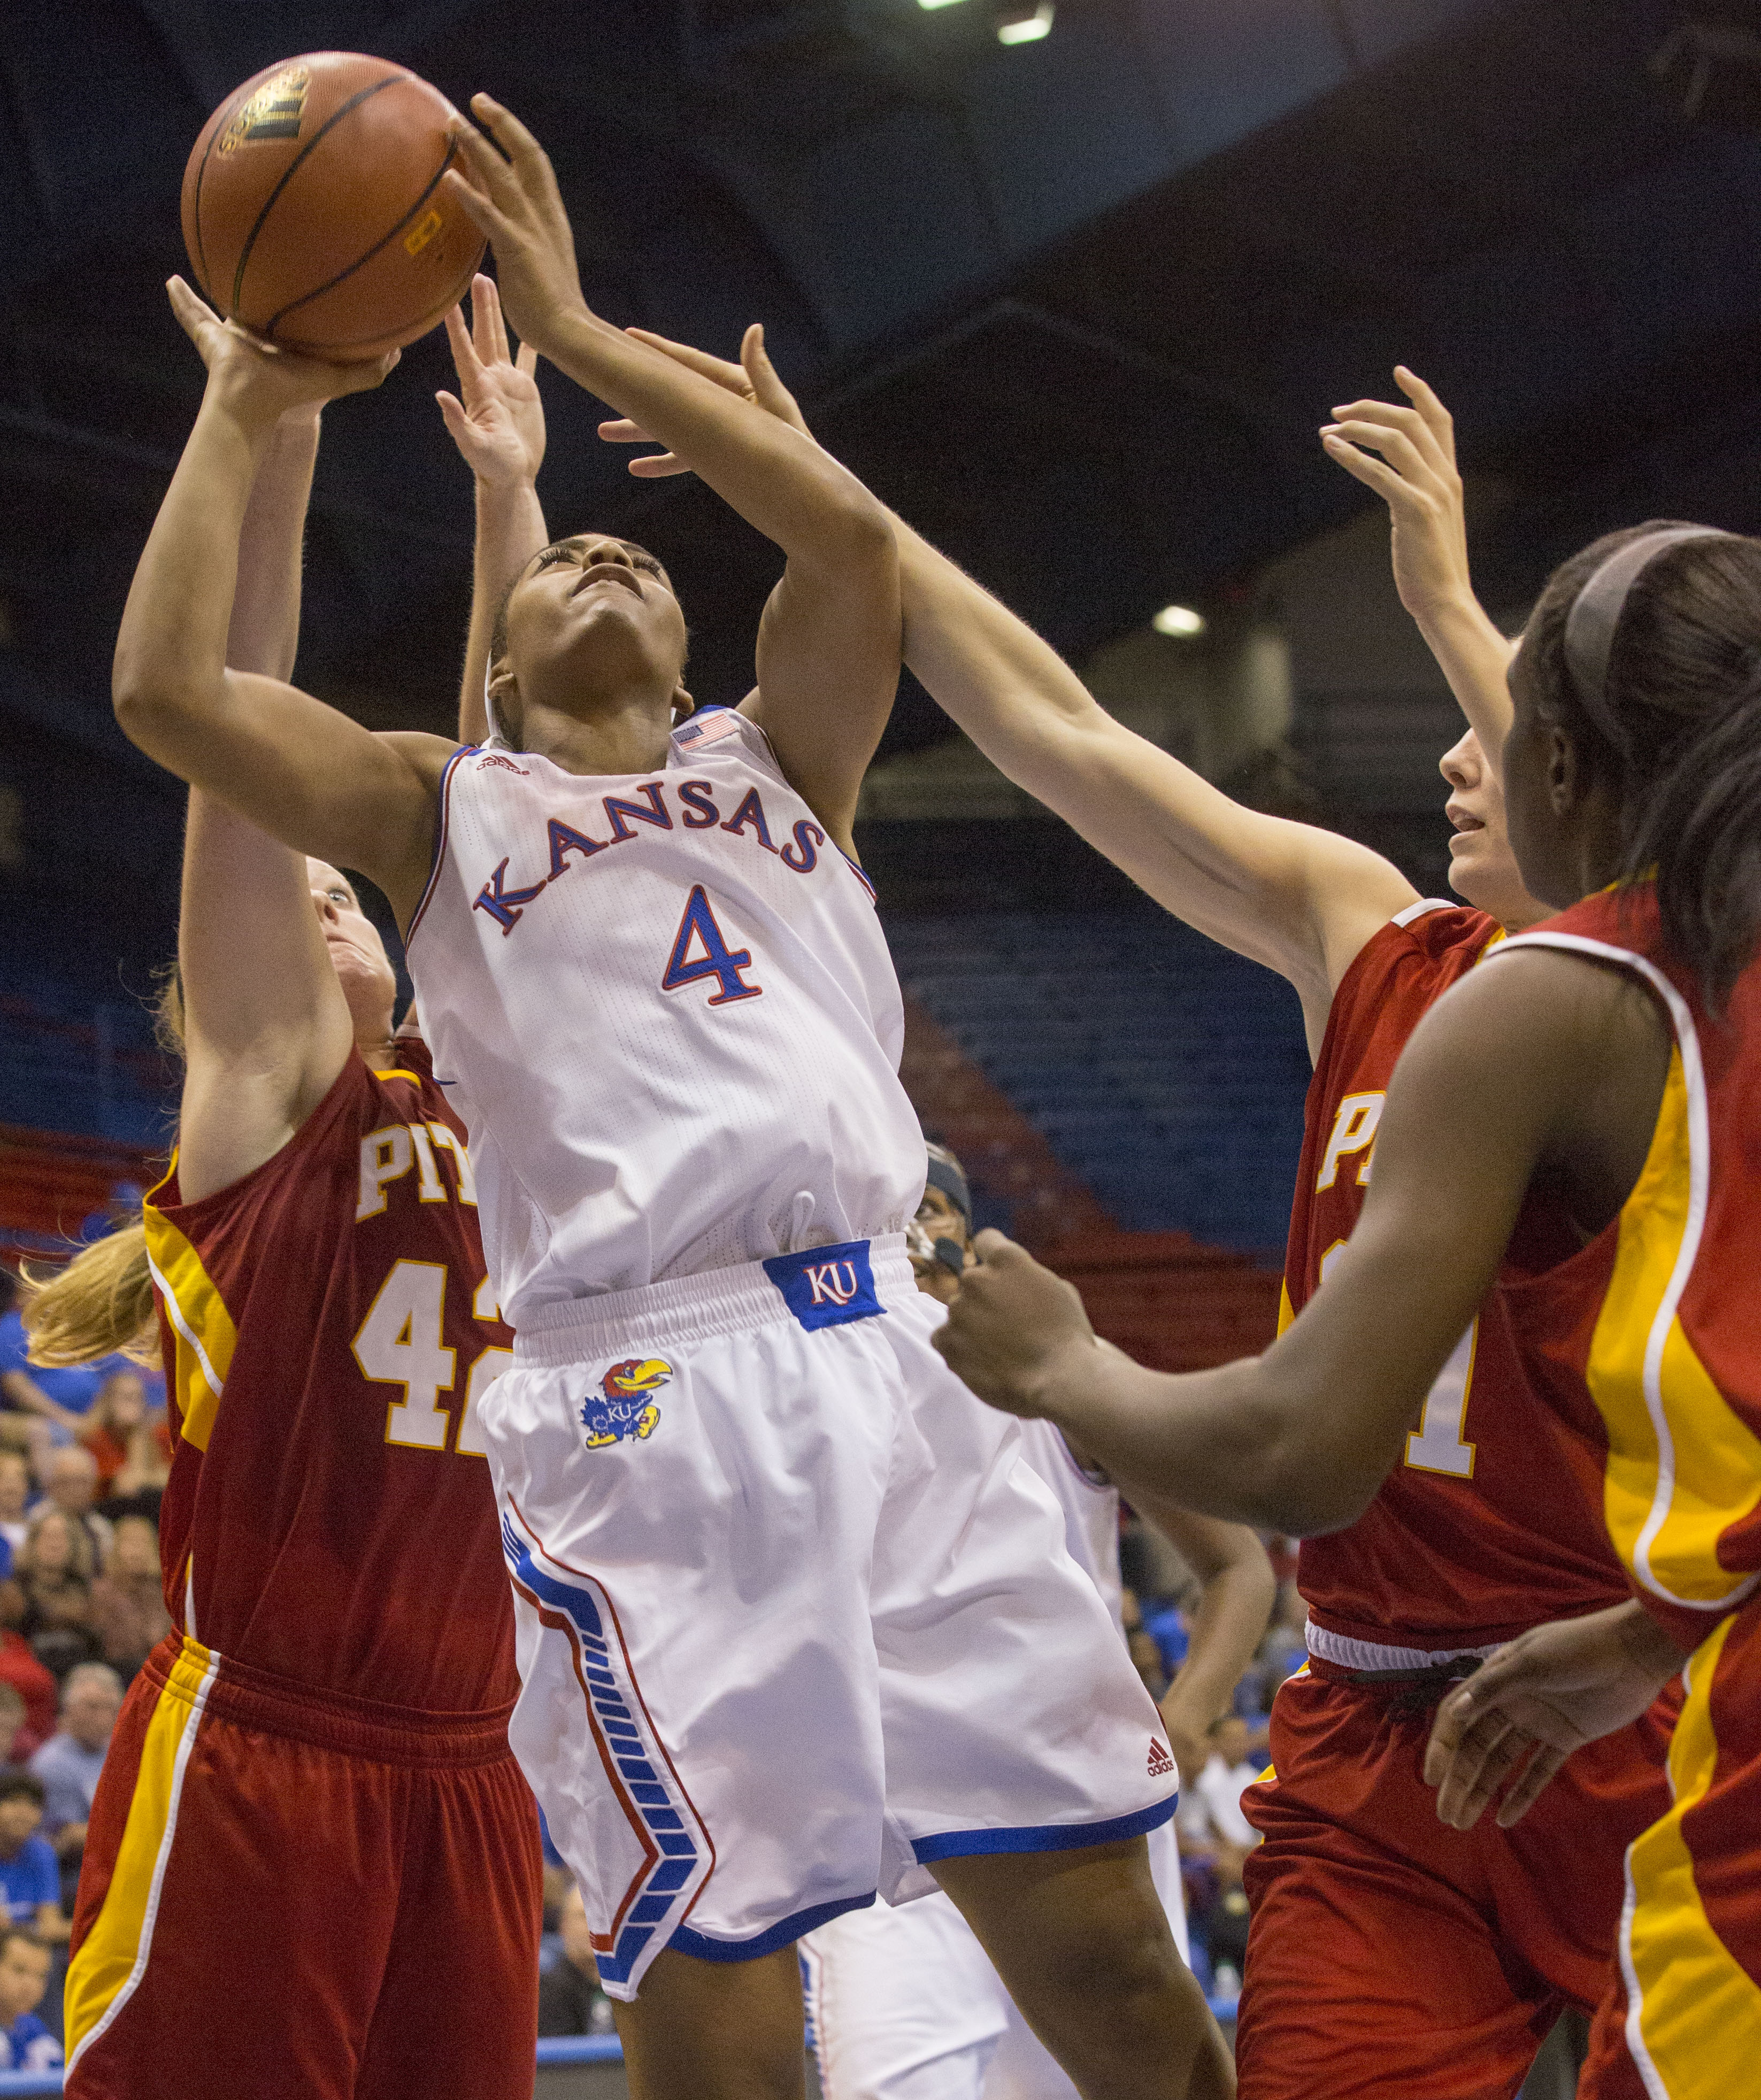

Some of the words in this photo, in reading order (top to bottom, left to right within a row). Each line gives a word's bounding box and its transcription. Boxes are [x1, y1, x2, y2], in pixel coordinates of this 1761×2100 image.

[476, 757, 530, 775] adidas
[473, 780, 825, 936] KANSAS
[662, 884, 763, 1006] 4
[804, 1261, 857, 1306] KU
[607, 1403, 632, 1423] KU
[1147, 1758, 1174, 1777] adidas
